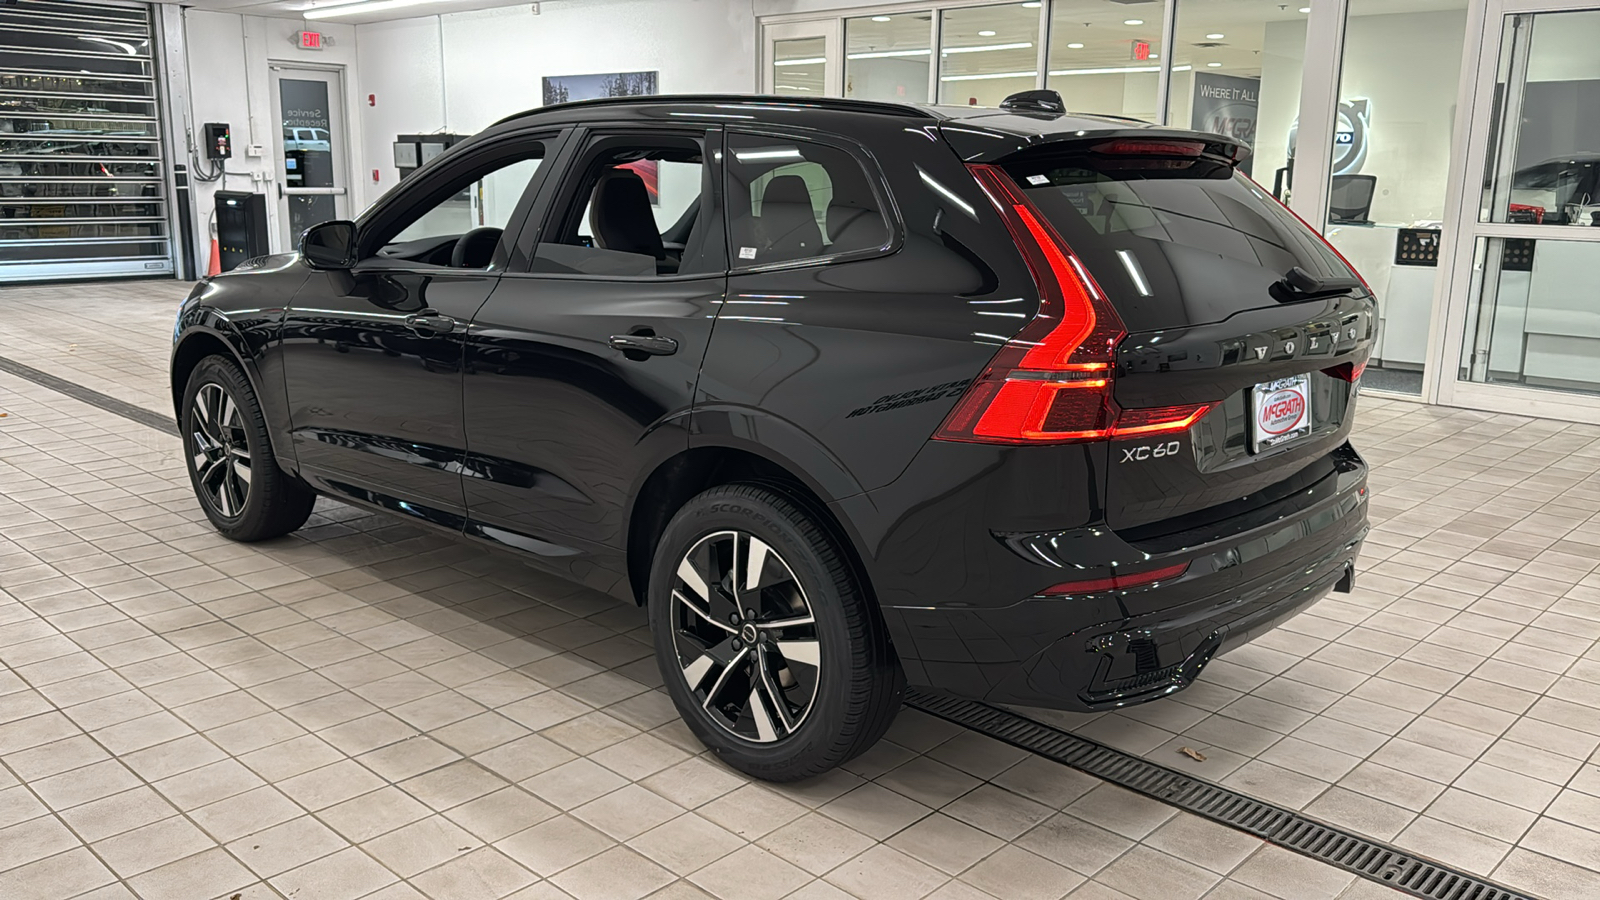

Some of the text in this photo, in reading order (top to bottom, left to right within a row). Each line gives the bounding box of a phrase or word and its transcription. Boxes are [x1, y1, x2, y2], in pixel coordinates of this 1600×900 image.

[302, 31, 320, 47] EXIT
[1200, 84, 1256, 102] WHERE IT ALL
[1213, 116, 1257, 138] McGRA
[1254, 327, 1357, 360] VOLVO
[1119, 441, 1180, 463] XC60
[710, 503, 794, 543] SCORPION
